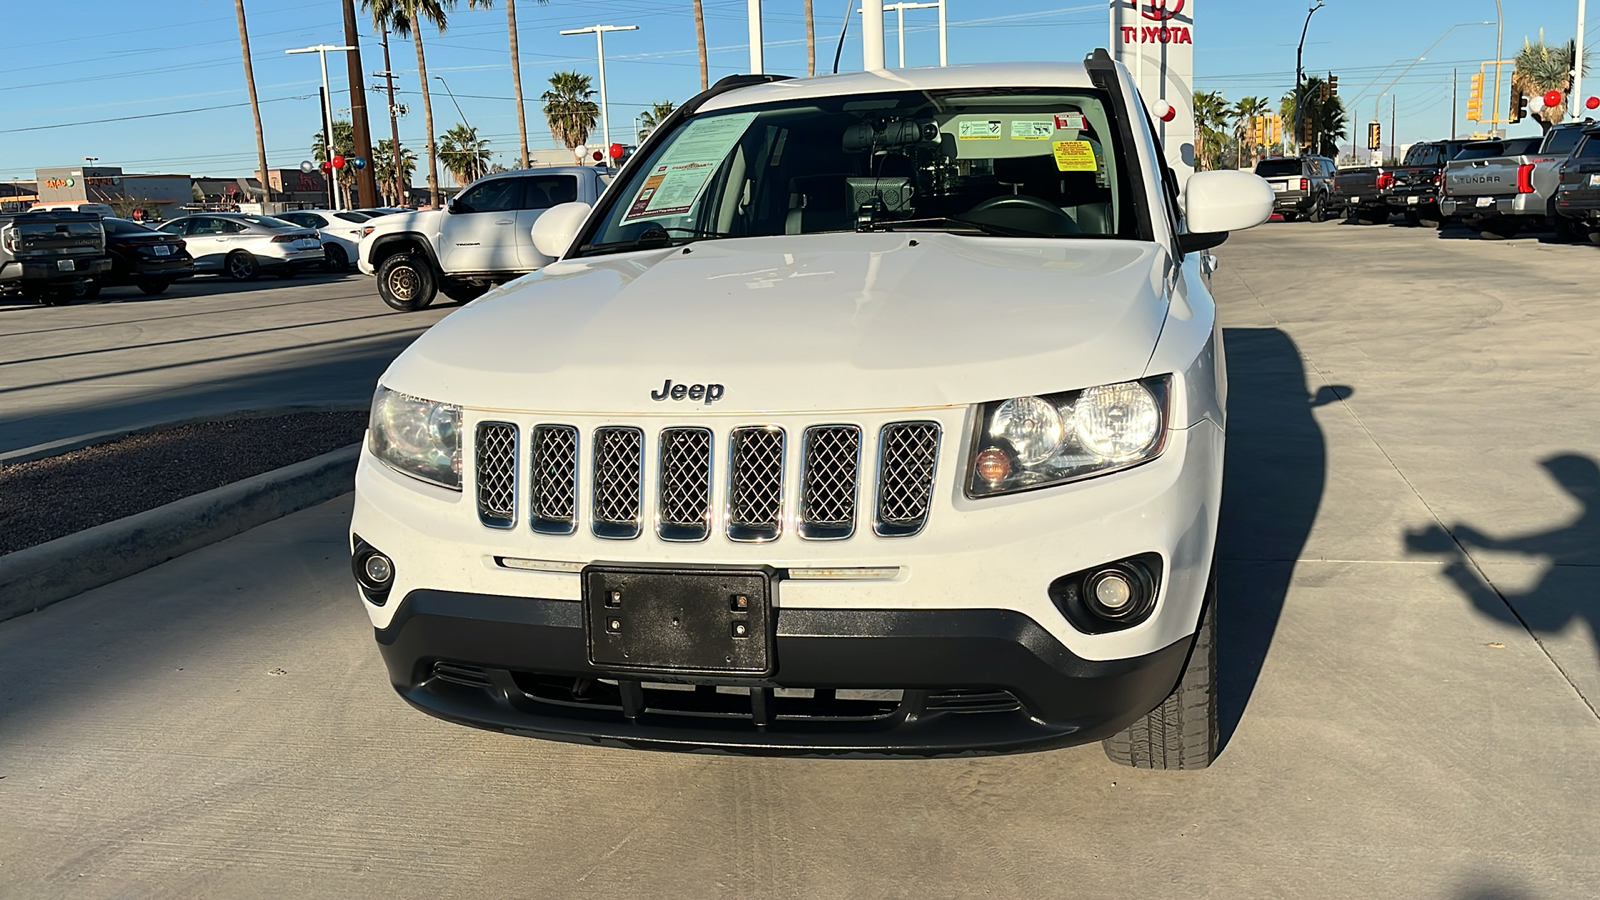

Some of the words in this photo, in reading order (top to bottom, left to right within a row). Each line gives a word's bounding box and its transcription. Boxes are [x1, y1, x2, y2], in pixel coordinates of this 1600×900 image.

[1120, 26, 1192, 44] TOYOTA
[1460, 176, 1501, 184] TUNDRA
[650, 379, 725, 405] Jeep
